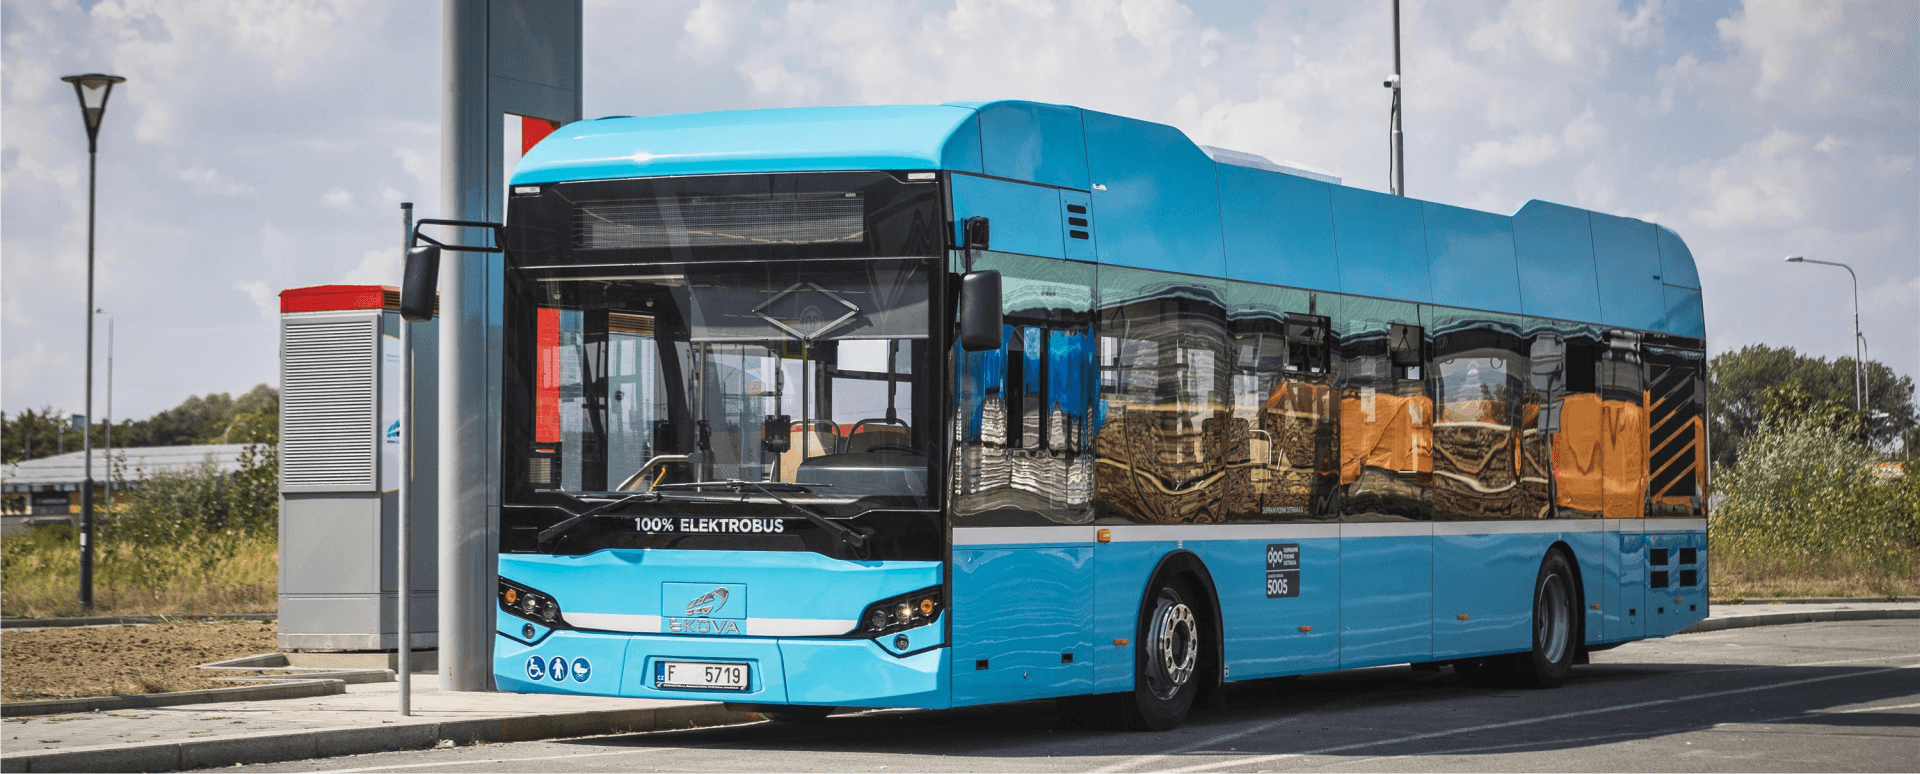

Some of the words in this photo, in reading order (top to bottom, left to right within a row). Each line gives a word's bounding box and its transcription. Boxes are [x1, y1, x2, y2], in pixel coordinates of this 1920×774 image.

[635, 517, 674, 532] 100%
[680, 518, 784, 533] ELEKTROBUS
[1268, 578, 1288, 595] 5005
[669, 618, 741, 634] EKOVA
[668, 665, 676, 681] F
[705, 666, 740, 684] 5719
